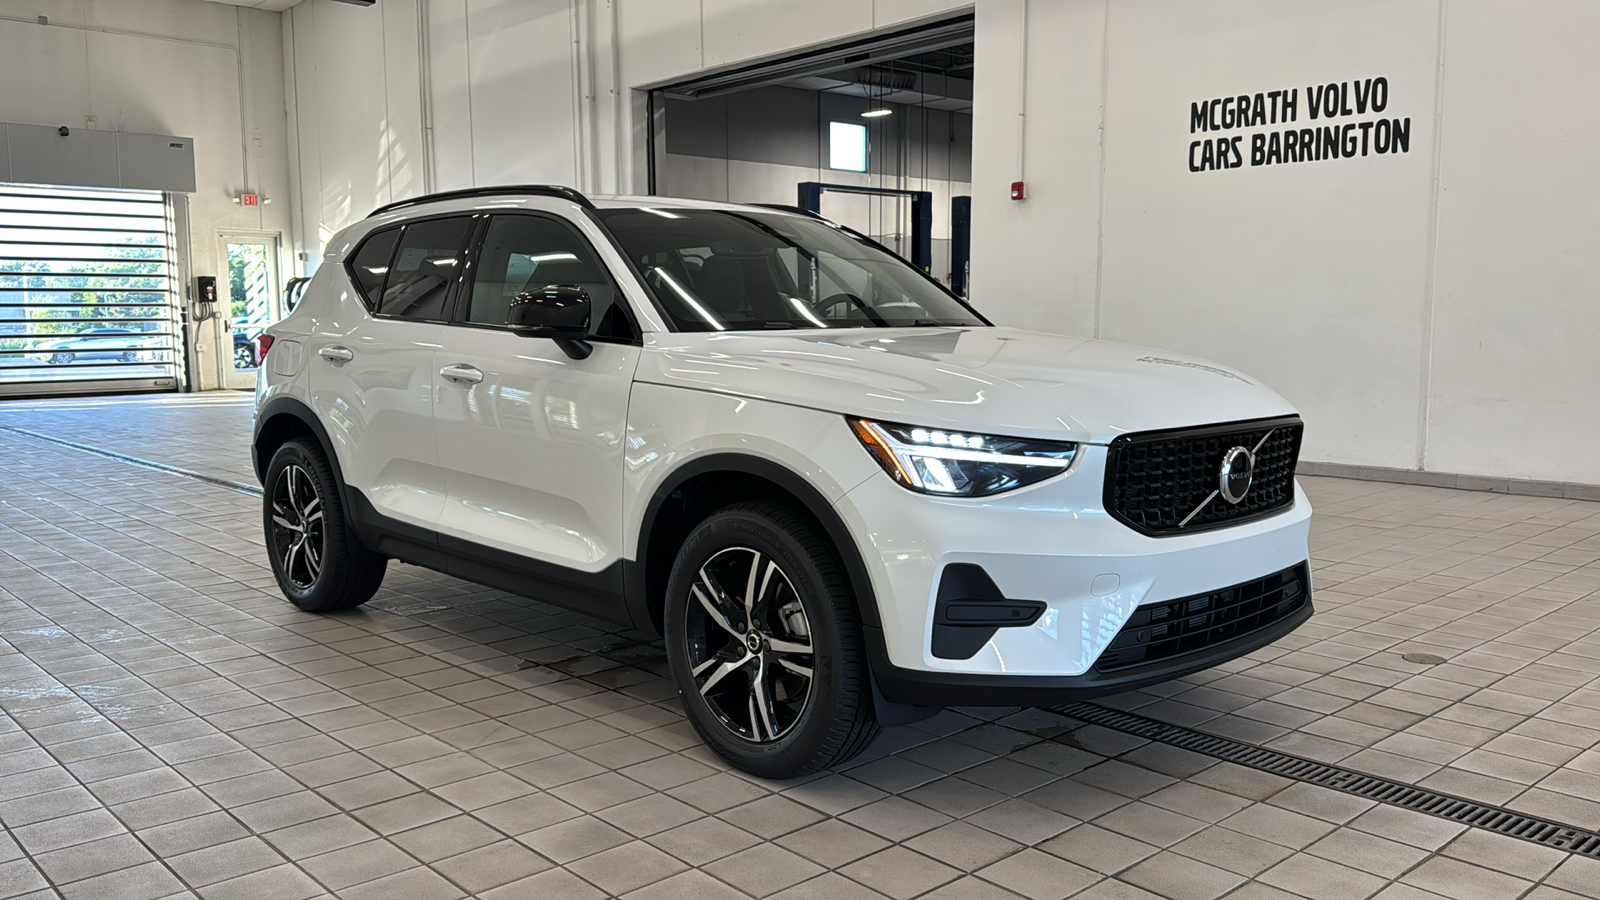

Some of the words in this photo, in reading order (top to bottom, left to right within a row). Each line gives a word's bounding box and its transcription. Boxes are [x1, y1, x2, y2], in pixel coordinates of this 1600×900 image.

[1190, 88, 1298, 133] MCGRATH
[1306, 77, 1388, 119] VOLVO
[1189, 136, 1242, 172] CARS
[1250, 118, 1410, 166] BARRINGTON
[244, 194, 258, 206] EXIT
[1229, 471, 1252, 480] VOLVO
